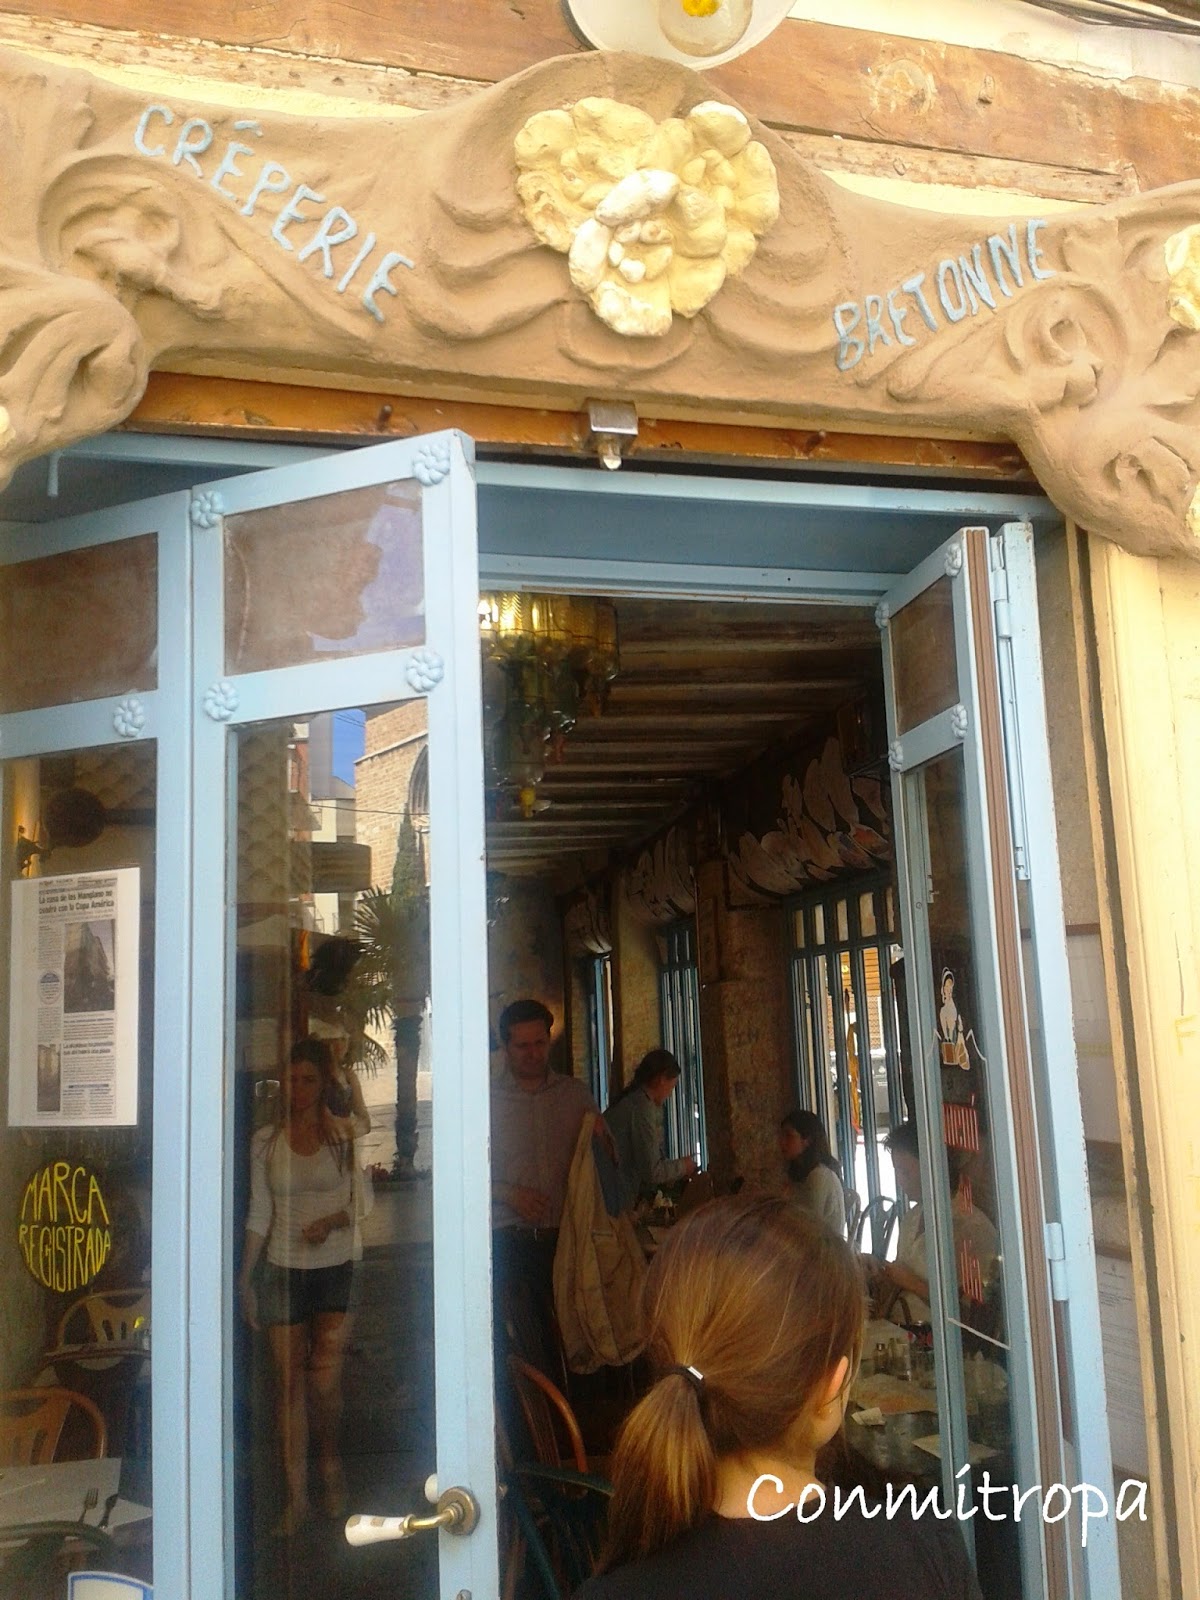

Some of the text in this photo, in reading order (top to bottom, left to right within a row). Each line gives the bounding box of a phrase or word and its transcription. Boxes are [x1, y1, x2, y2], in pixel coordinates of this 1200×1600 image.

[833, 218, 1057, 372] BRETONNE
[21, 1162, 110, 1225] MARCA
[18, 1224, 111, 1292] REGISTRADA
